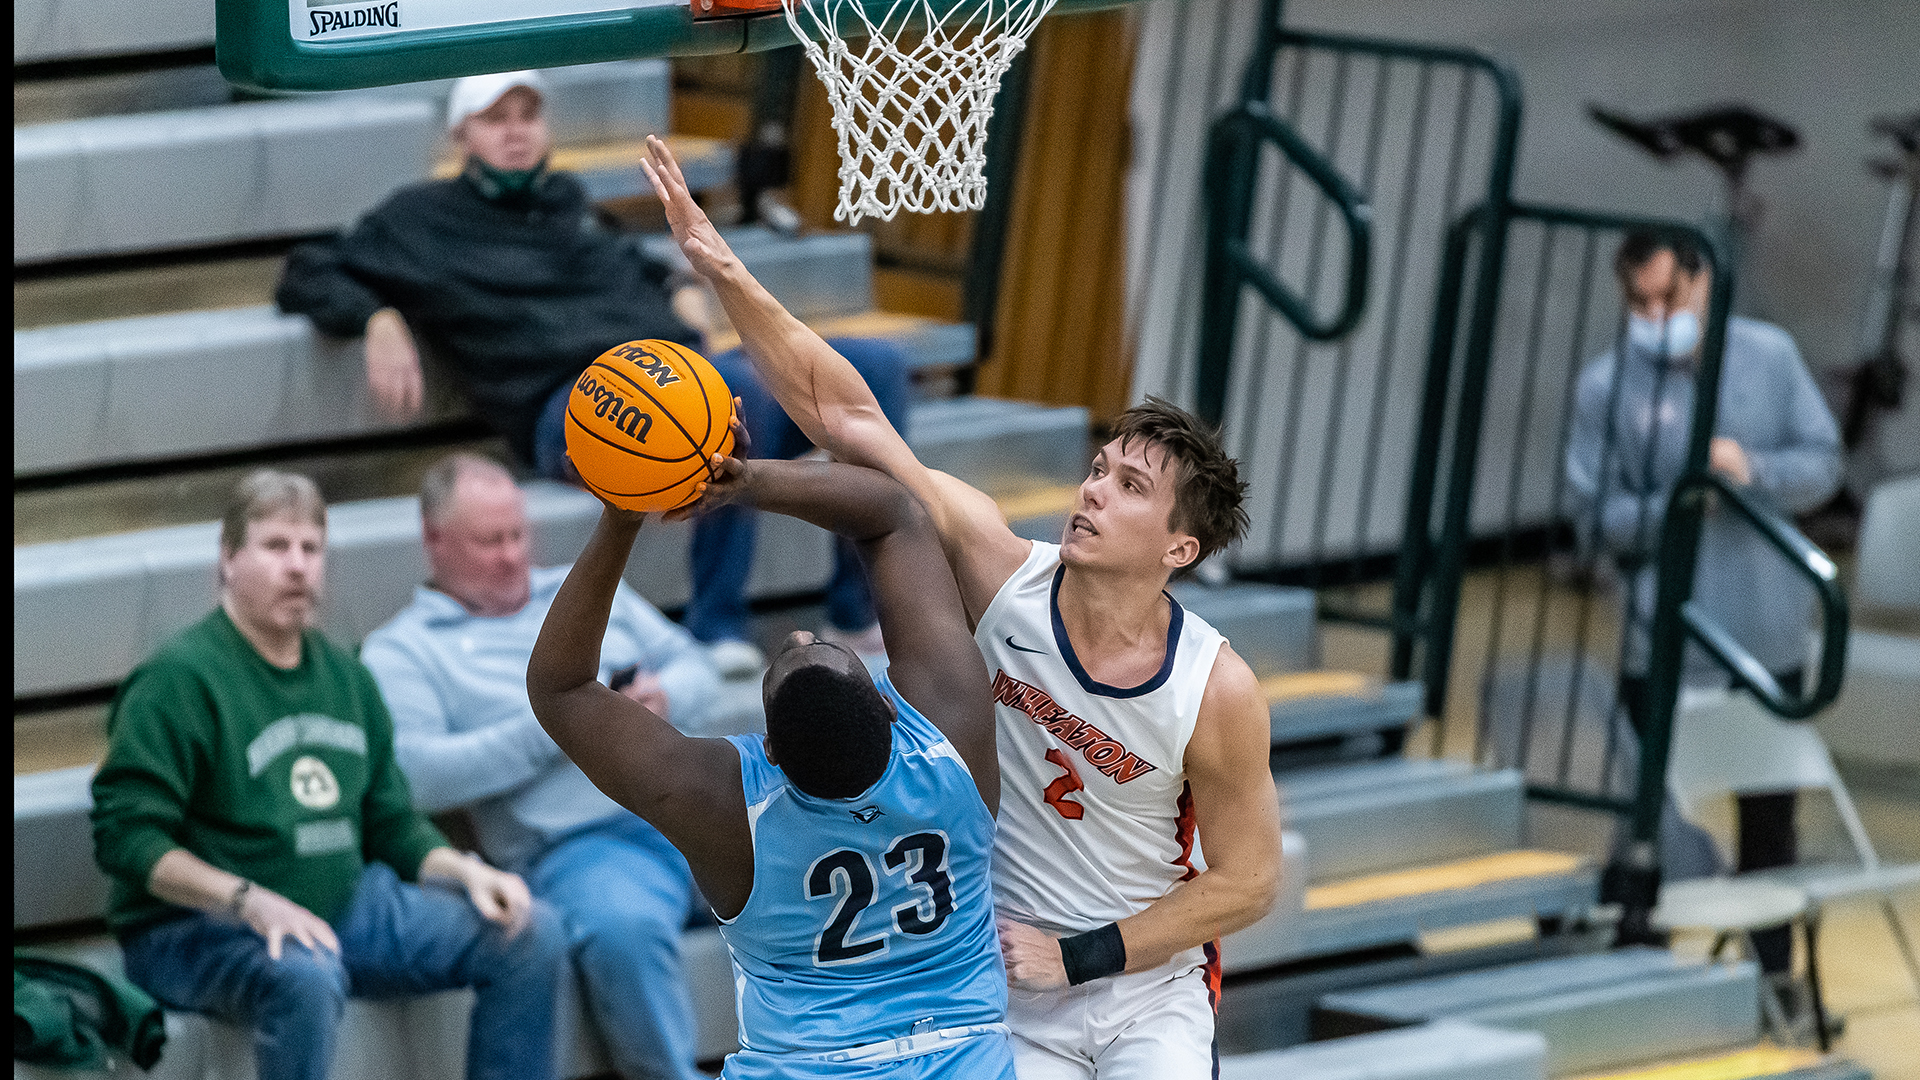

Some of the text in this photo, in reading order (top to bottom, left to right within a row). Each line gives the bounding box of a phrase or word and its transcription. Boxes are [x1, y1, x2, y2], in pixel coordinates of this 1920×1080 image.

[309, 1, 398, 37] SPALDING
[611, 344, 681, 388] NCAA
[577, 372, 653, 445] Wilson
[992, 668, 1158, 785] WHEATON
[1043, 748, 1085, 821] 2
[803, 829, 958, 968] 23
